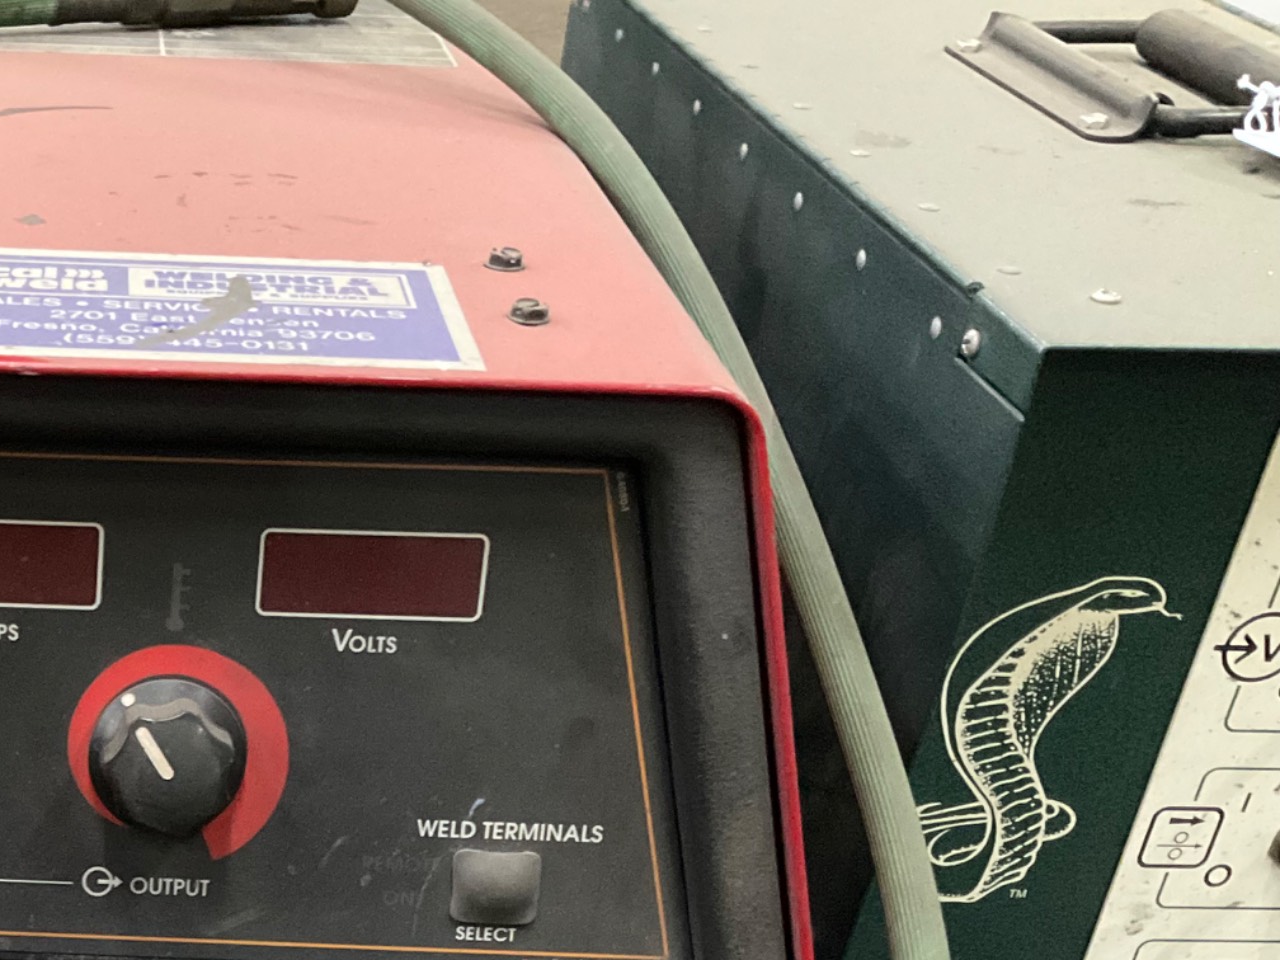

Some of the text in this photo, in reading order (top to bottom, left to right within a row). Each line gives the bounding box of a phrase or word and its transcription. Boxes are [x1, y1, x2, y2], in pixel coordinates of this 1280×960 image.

[49, 309, 320, 328] 2701 East ensen
[102, 299, 222, 312] SERVIC
[271, 305, 407, 320] RENTALS
[276, 328, 376, 342] 93706
[417, 819, 604, 843] WELD TERMINALS
[129, 876, 211, 897] OUTPUT
[455, 926, 517, 942] SELECT
